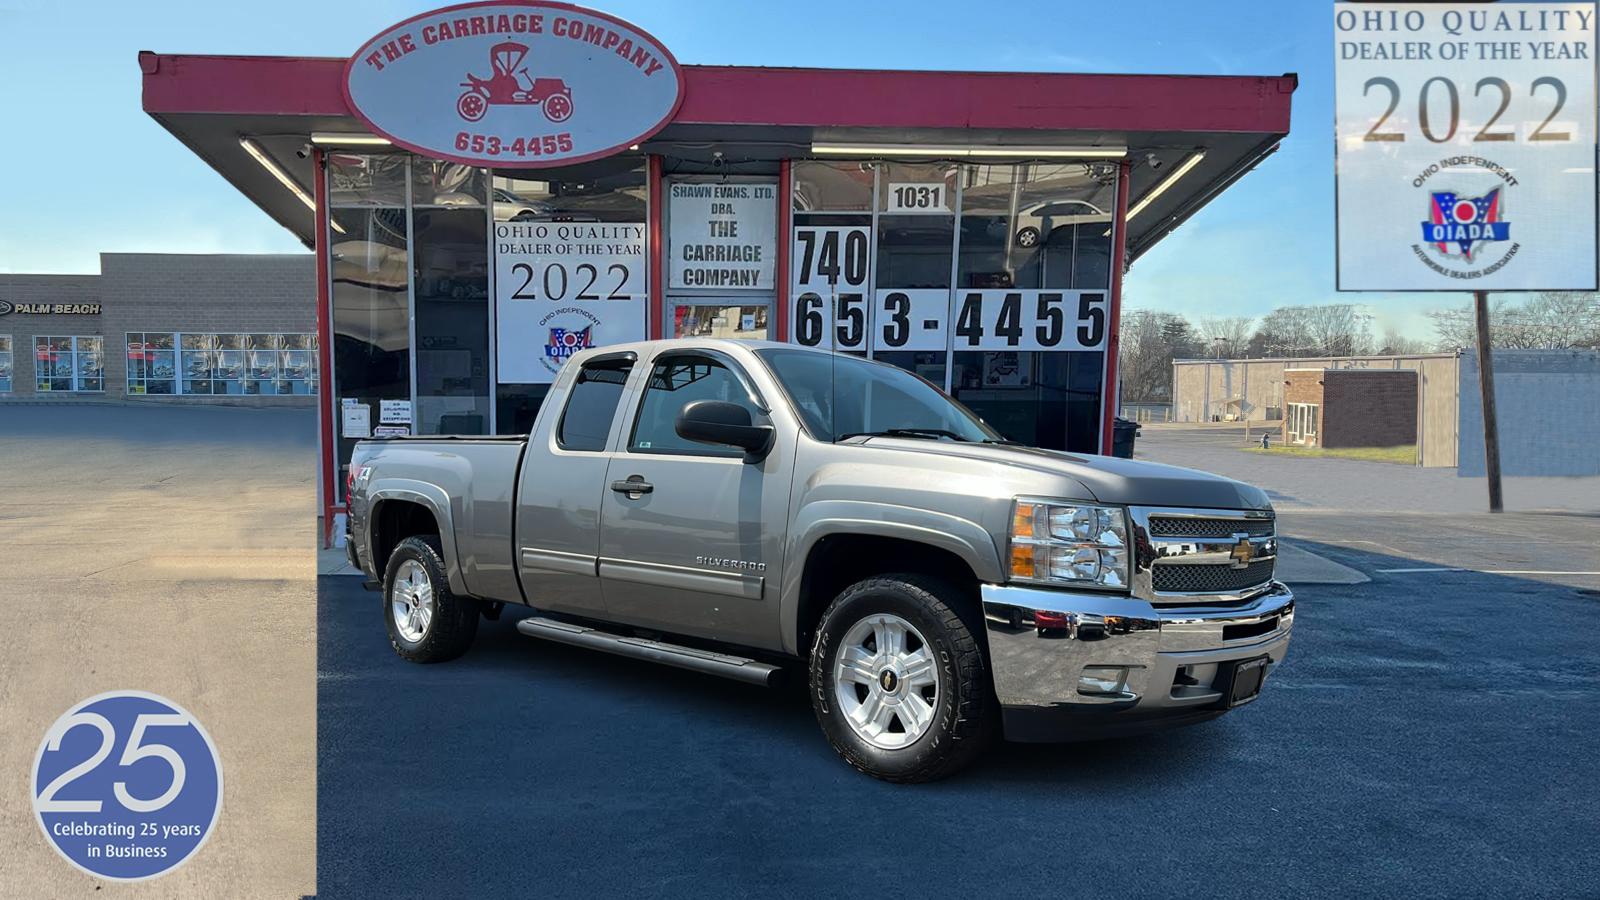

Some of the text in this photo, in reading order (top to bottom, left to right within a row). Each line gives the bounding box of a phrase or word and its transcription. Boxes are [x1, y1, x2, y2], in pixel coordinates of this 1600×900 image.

[1336, 10, 1593, 35] OHIO QUALITY
[365, 13, 664, 77] THE CARRIAGE COMPANY
[1340, 41, 1589, 60] DEALER OF THE YEAR
[1363, 76, 1571, 143] 2022
[454, 131, 574, 157] 653-4455
[1412, 155, 1519, 188] OHIO INDEPENDENT
[672, 185, 712, 198] SHAWN
[754, 187, 775, 199] LTD.
[894, 186, 940, 208] 1031
[711, 203, 736, 215] DBA.
[497, 226, 644, 241] OHIO QUALITY
[709, 220, 738, 238] THE
[1432, 223, 1496, 240] OIADA
[499, 243, 641, 255] DEALER OF THE YEAR
[683, 244, 762, 262] CARRIAGE
[797, 230, 868, 286] 740
[511, 262, 631, 301] 2022
[683, 268, 760, 286] COMPANY
[14, 303, 100, 314] PALM BEACH
[555, 307, 601, 326] INDEPENDENT
[696, 556, 767, 571] SILVERADO
